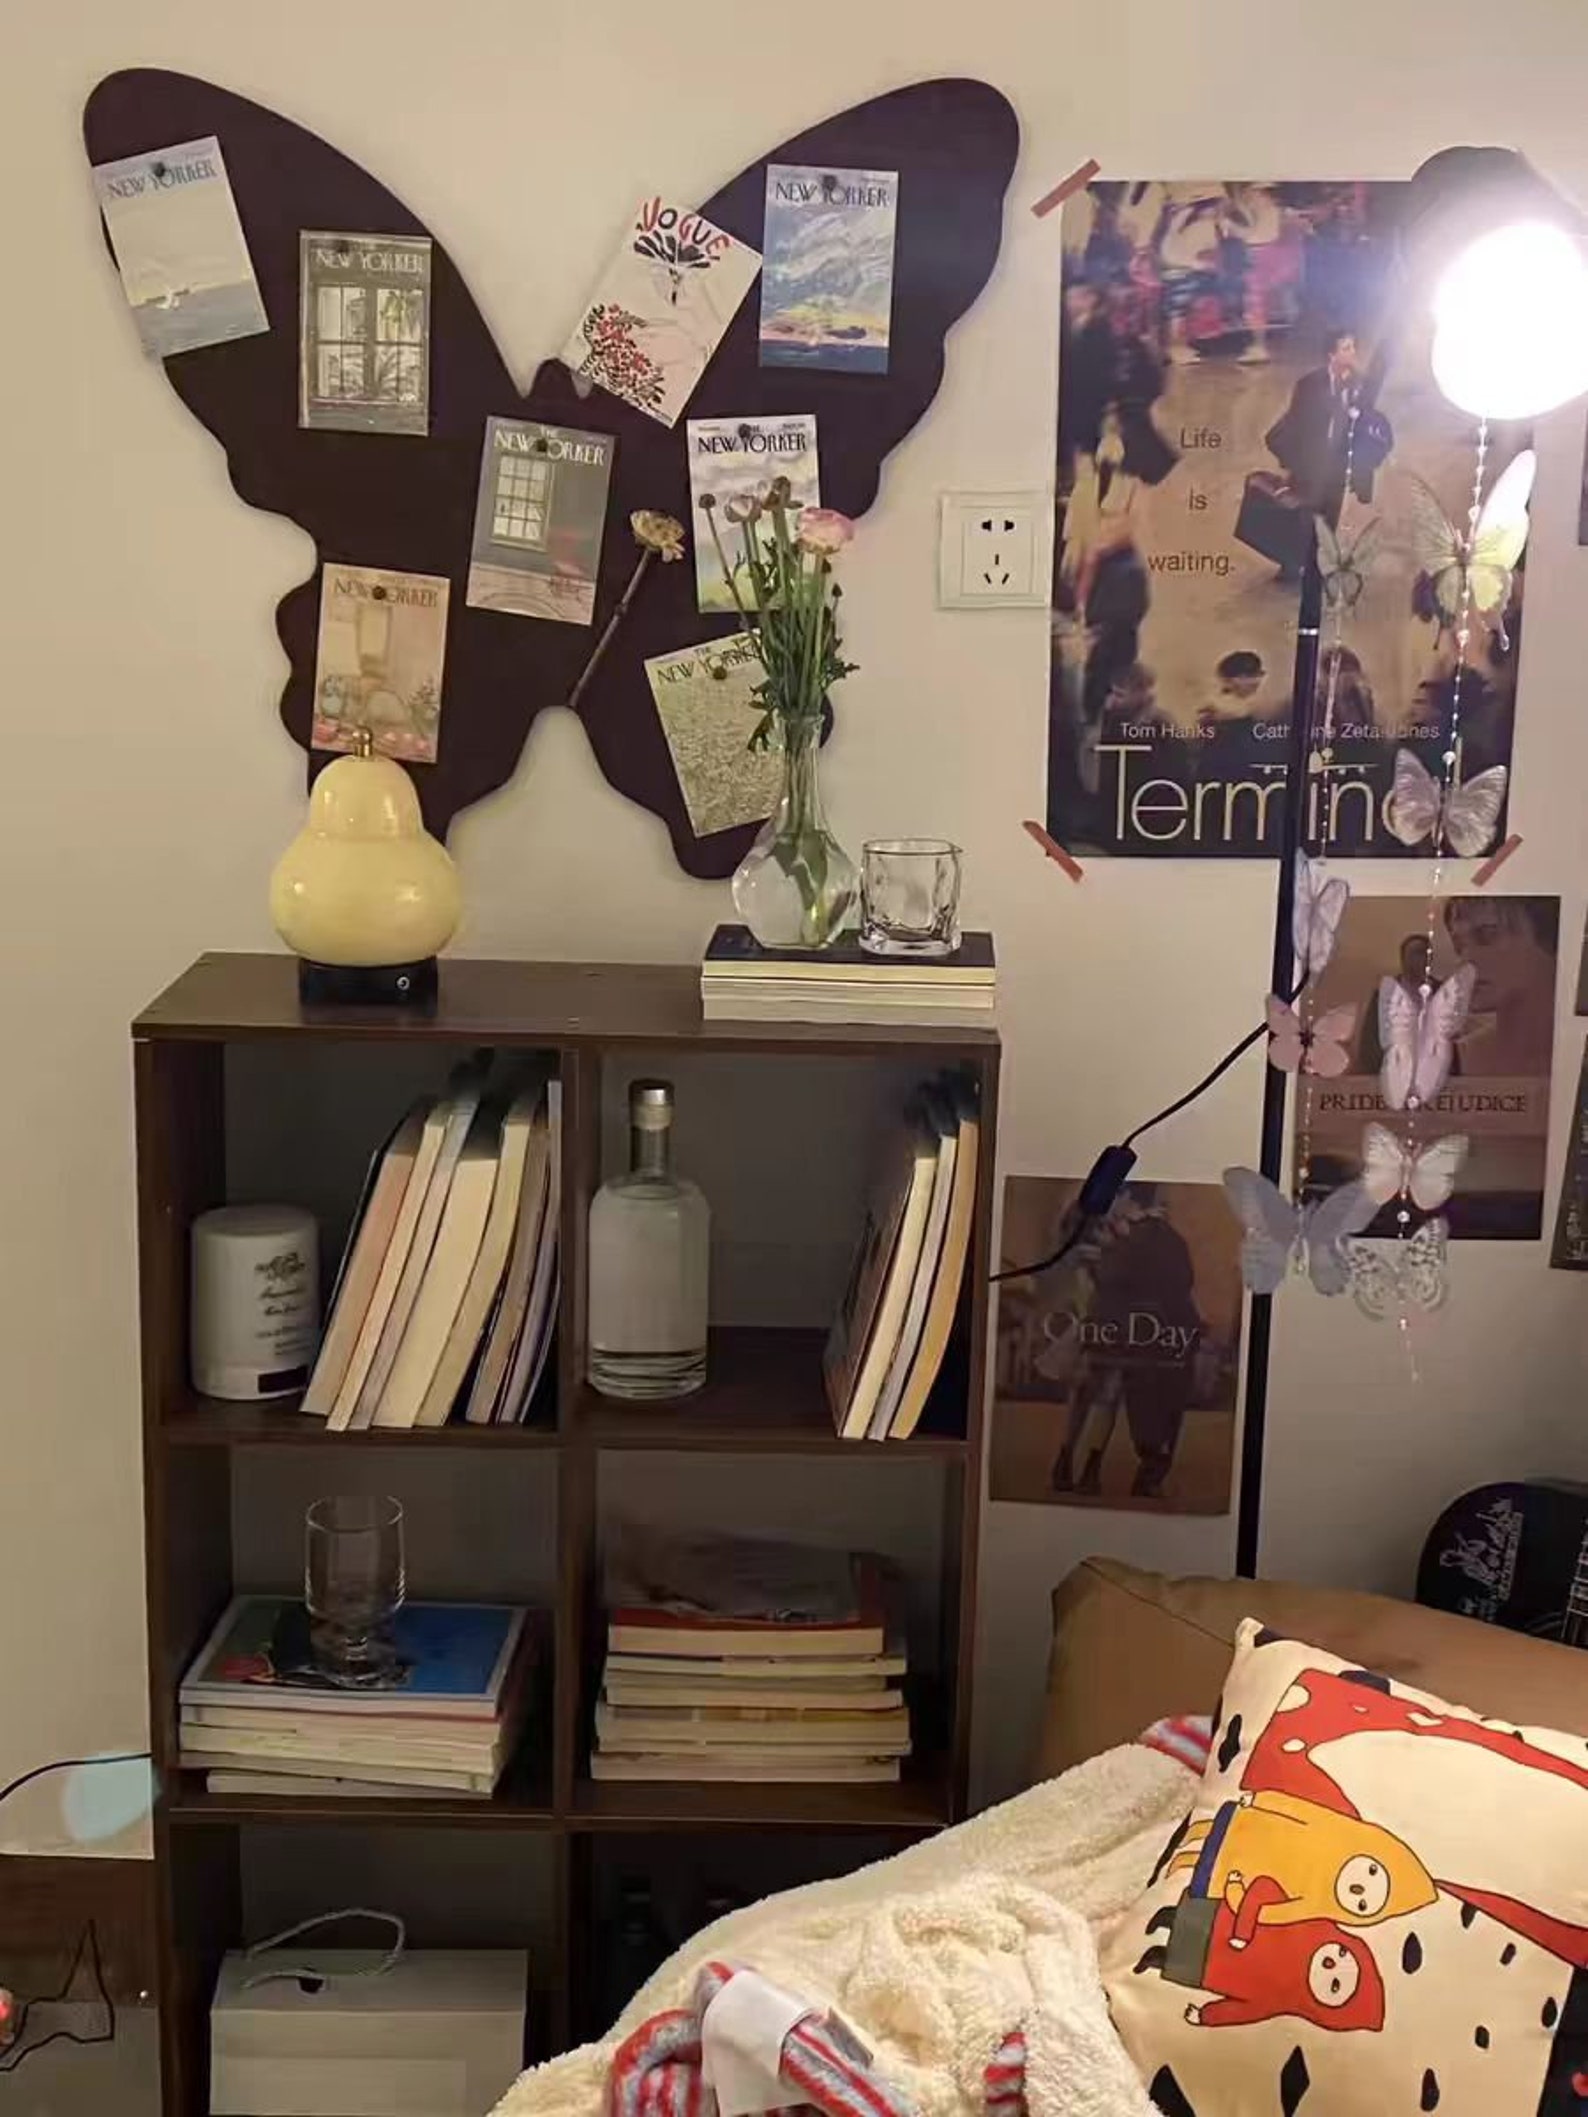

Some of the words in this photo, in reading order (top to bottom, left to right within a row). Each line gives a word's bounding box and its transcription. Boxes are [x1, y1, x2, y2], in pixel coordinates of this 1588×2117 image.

[107, 175, 146, 198] NEW
[776, 182, 818, 202] NEW
[643, 196, 731, 256] VOGUE
[494, 430, 537, 453] NEW
[698, 436, 738, 455] NEW
[1180, 427, 1223, 449] Life
[1148, 551, 1236, 576] waiting.
[656, 660, 696, 686] NEW
[1120, 722, 1157, 739] Tom
[1161, 722, 1215, 739] Hanks
[1319, 1092, 1388, 1111] PRIDE
[1043, 1311, 1119, 1345] One
[1128, 1311, 1200, 1360] Day
